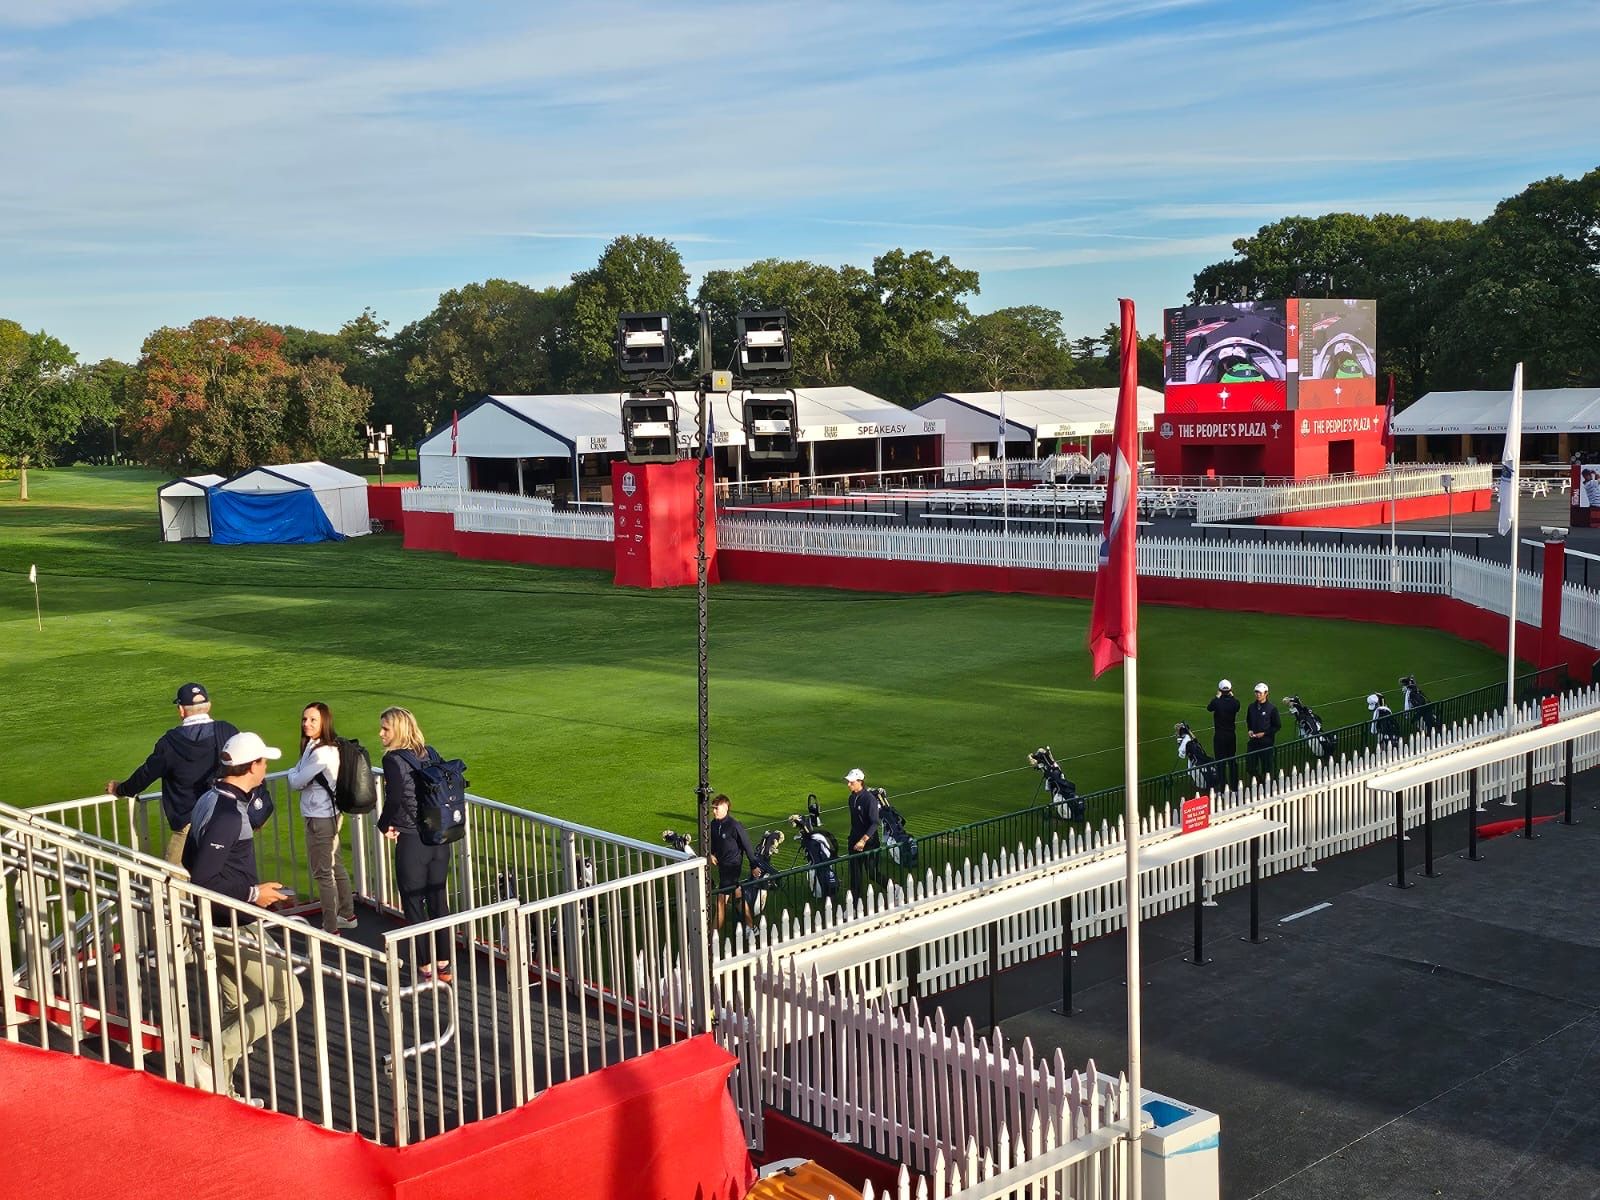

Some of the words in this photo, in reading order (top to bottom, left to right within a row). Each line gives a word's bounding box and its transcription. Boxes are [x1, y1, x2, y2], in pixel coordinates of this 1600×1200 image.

[858, 424, 907, 436] SPEAKEASY
[1178, 424, 1194, 438] THE
[1196, 422, 1236, 438] PEOPLE'S
[1239, 422, 1267, 437] PLAZA
[1313, 420, 1327, 435] THE
[1328, 418, 1352, 434] PEOPLE'S
[1353, 417, 1371, 432] PLAZA
